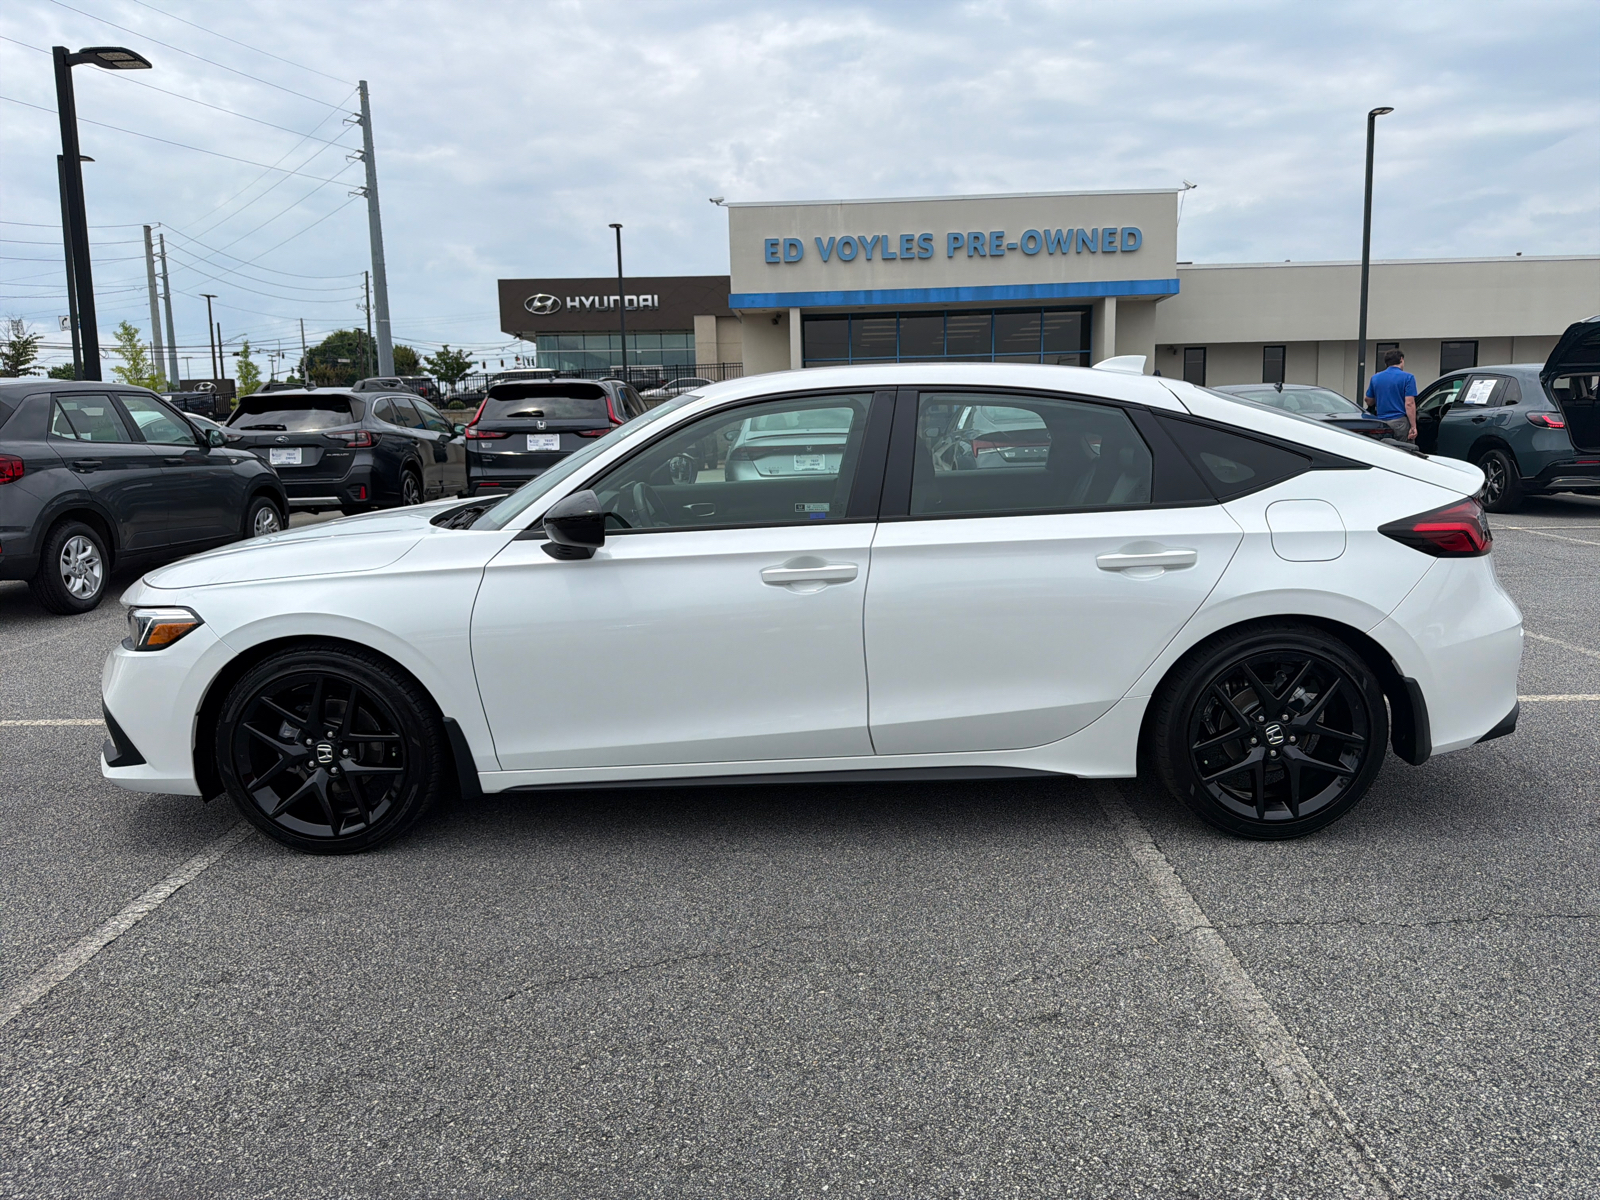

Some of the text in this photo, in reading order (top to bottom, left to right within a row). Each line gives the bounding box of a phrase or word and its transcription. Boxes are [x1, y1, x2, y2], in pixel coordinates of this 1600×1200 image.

[765, 227, 1143, 263] ED VOYLES PRE-OWNED
[566, 294, 659, 312] HYUNDAI
